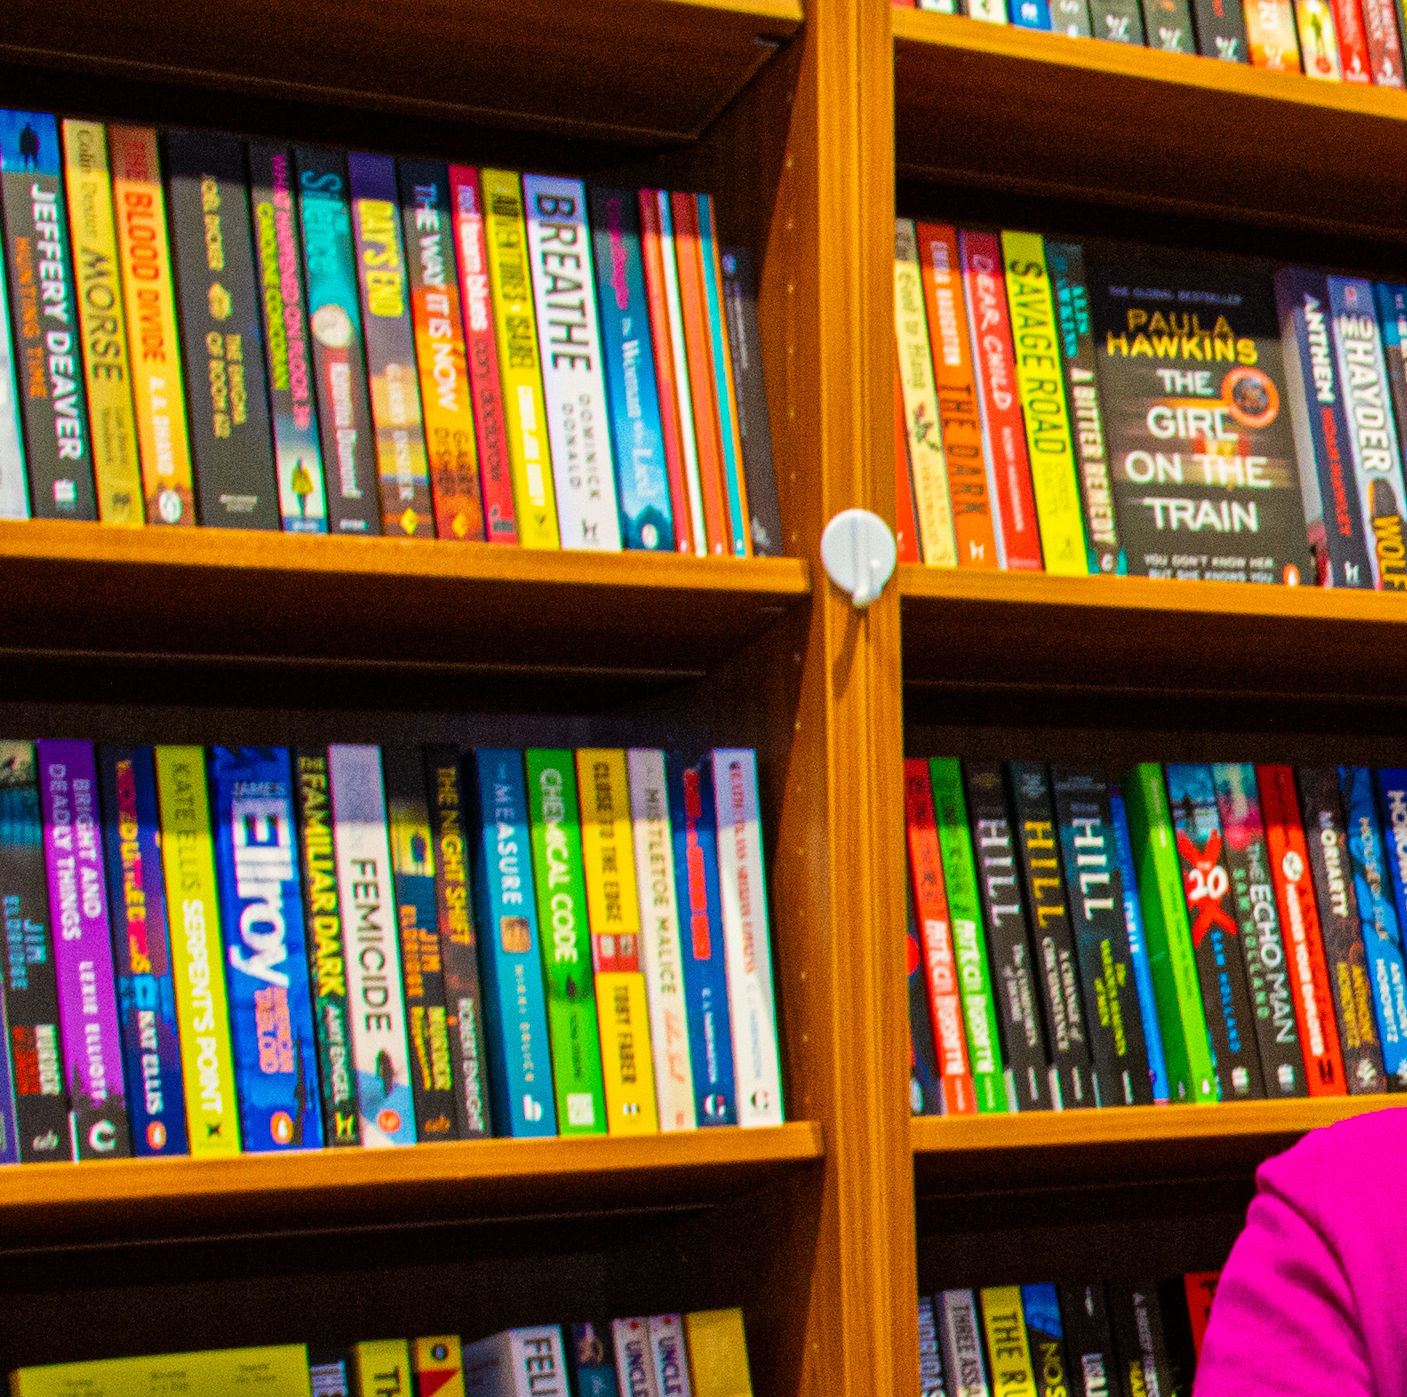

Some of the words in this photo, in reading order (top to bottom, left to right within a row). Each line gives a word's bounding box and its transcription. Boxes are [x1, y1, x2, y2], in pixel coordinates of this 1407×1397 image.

[124, 190, 160, 282] BLOOD
[357, 200, 399, 269] DAY'S
[415, 183, 441, 233] THE
[30, 184, 68, 325] JEFFERY
[366, 269, 405, 319] END
[420, 233, 449, 289] WAY
[535, 192, 592, 375] BREATHE
[972, 252, 996, 331] DEAR
[79, 245, 124, 384] MORSE
[136, 287, 168, 364] DIVIDE
[1009, 258, 1054, 373] SAVAGE
[1107, 331, 1259, 365] HAWKINS
[1126, 308, 1233, 338] PAULA
[1303, 293, 1334, 404] ANTHEM
[27, 346, 47, 398] TIME
[45, 330, 84, 460] DEAVER
[432, 341, 459, 412] NOW
[940, 383, 976, 431] THE
[983, 335, 1011, 411] CHILD
[1156, 369, 1214, 396] THE
[1343, 332, 1393, 473] HAYDER
[1026, 377, 1066, 456] ROAD
[1147, 406, 1239, 441] GIRL
[948, 443, 988, 517] DARK
[1124, 451, 1183, 484] ON
[1195, 455, 1271, 488] THE
[1144, 497, 1260, 532] TRAIN
[50, 763, 72, 849] DEADLY
[73, 778, 95, 860] BRIGHT
[304, 769, 334, 914] FAMILIAR
[493, 784, 522, 904] MEASURE
[540, 769, 569, 889] CHEMICAL
[592, 762, 612, 814] CLOSE
[605, 882, 622, 923] EDGE
[648, 788, 669, 907] MISTLETOE
[977, 819, 1020, 926] HILL
[1024, 821, 1065, 928] HILL
[1072, 818, 1114, 920] HILL
[1188, 867, 1228, 899] 20
[1320, 811, 1347, 916] MORIARTY
[57, 857, 82, 940] THINGS
[80, 867, 101, 918] AND
[229, 802, 294, 989] Ellroy
[551, 893, 578, 964] CODE
[1249, 882, 1281, 969] ECHO
[313, 916, 345, 996] DARK
[350, 856, 392, 1035] FEMICIDE
[657, 918, 676, 996] MALICE
[1264, 975, 1296, 1043] MAN
[142, 1054, 163, 1115] ELLIS
[196, 1037, 222, 1115] POINT
[993, 1312, 1015, 1357] THE
